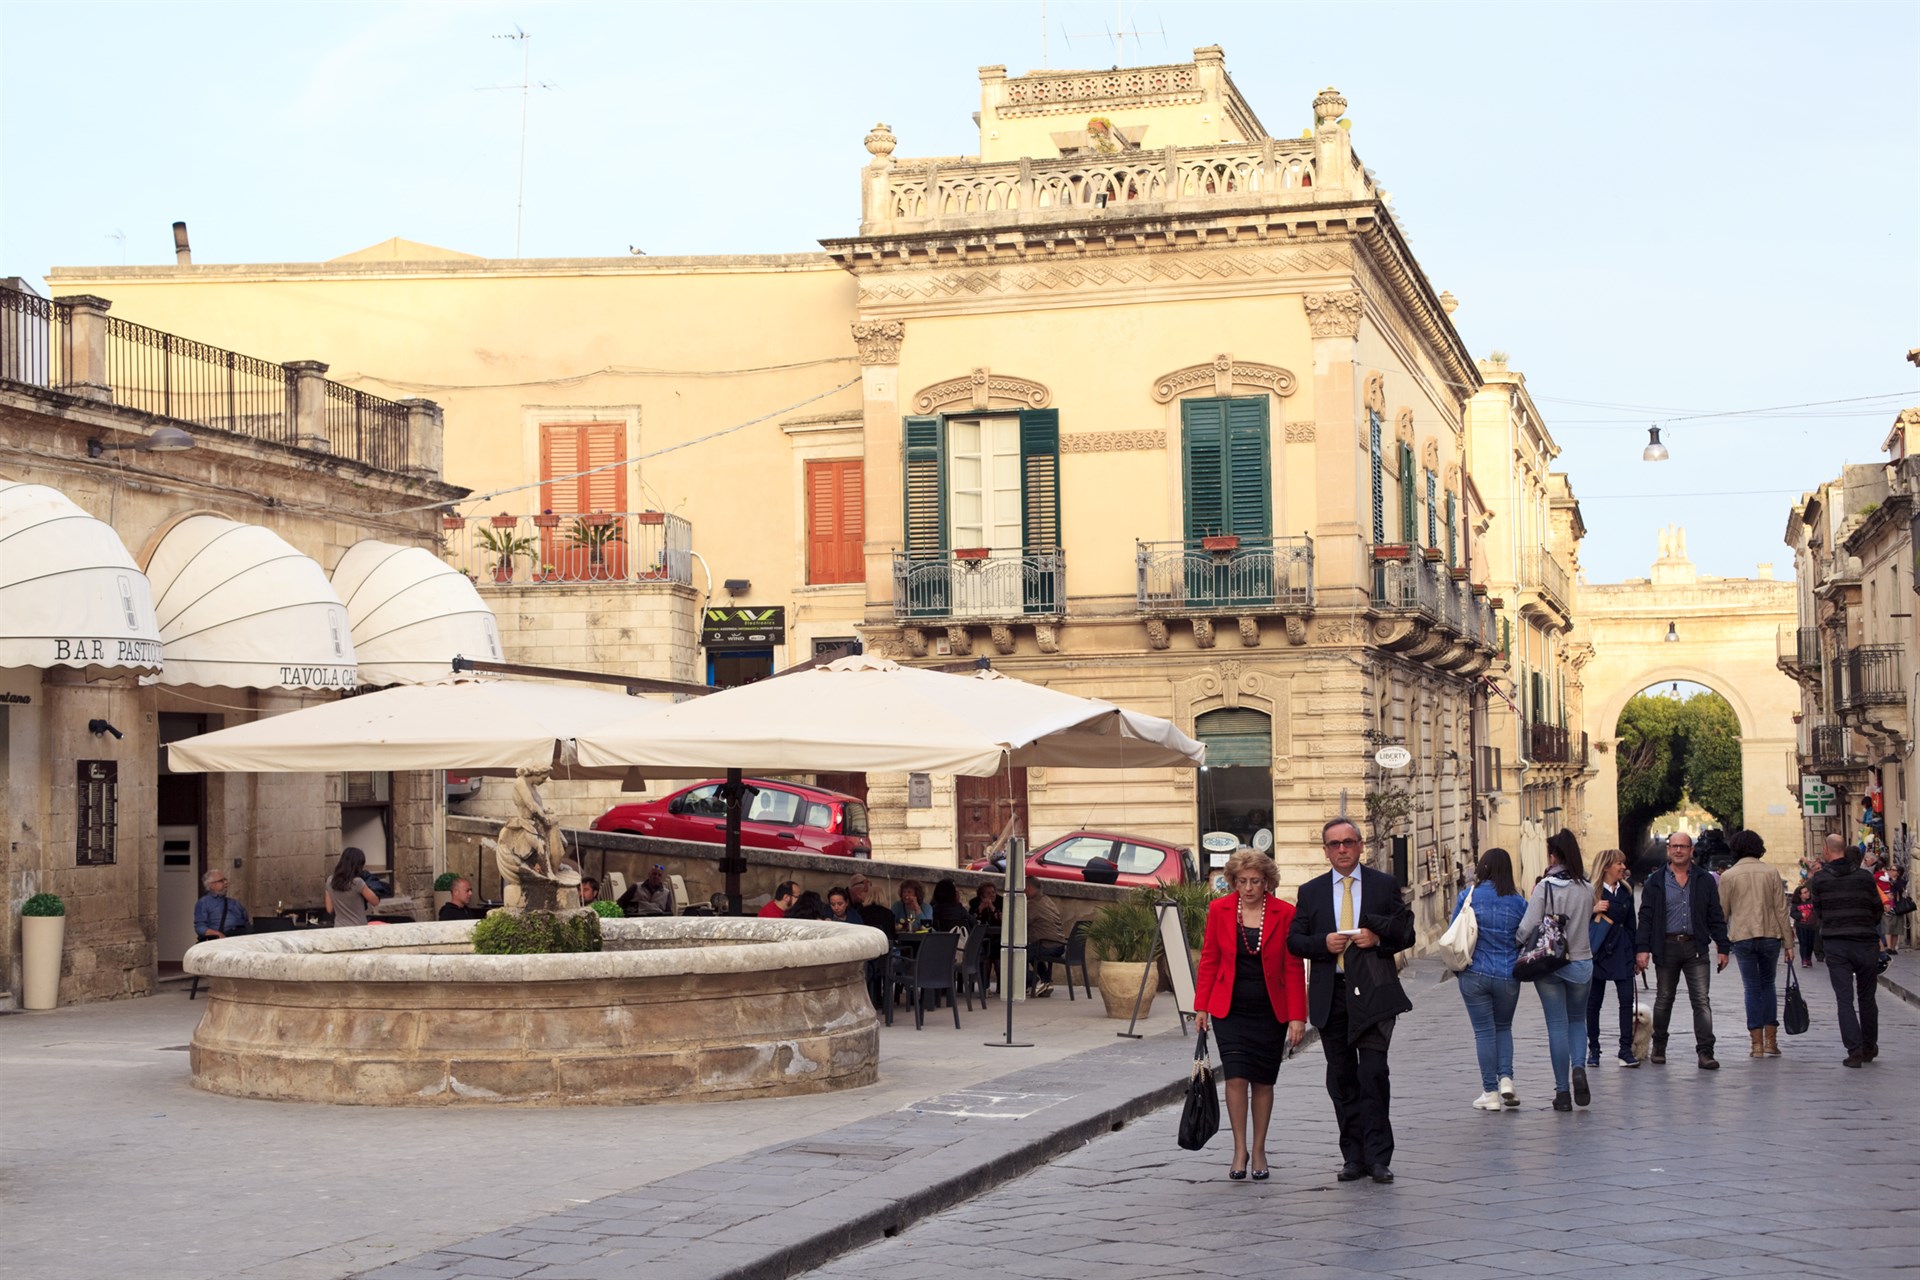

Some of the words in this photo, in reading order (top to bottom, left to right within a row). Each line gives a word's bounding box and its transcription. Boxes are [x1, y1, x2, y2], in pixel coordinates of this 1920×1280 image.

[54, 639, 104, 660] BAR
[117, 640, 163, 664] PASTIC
[280, 667, 339, 686] TAVOLA
